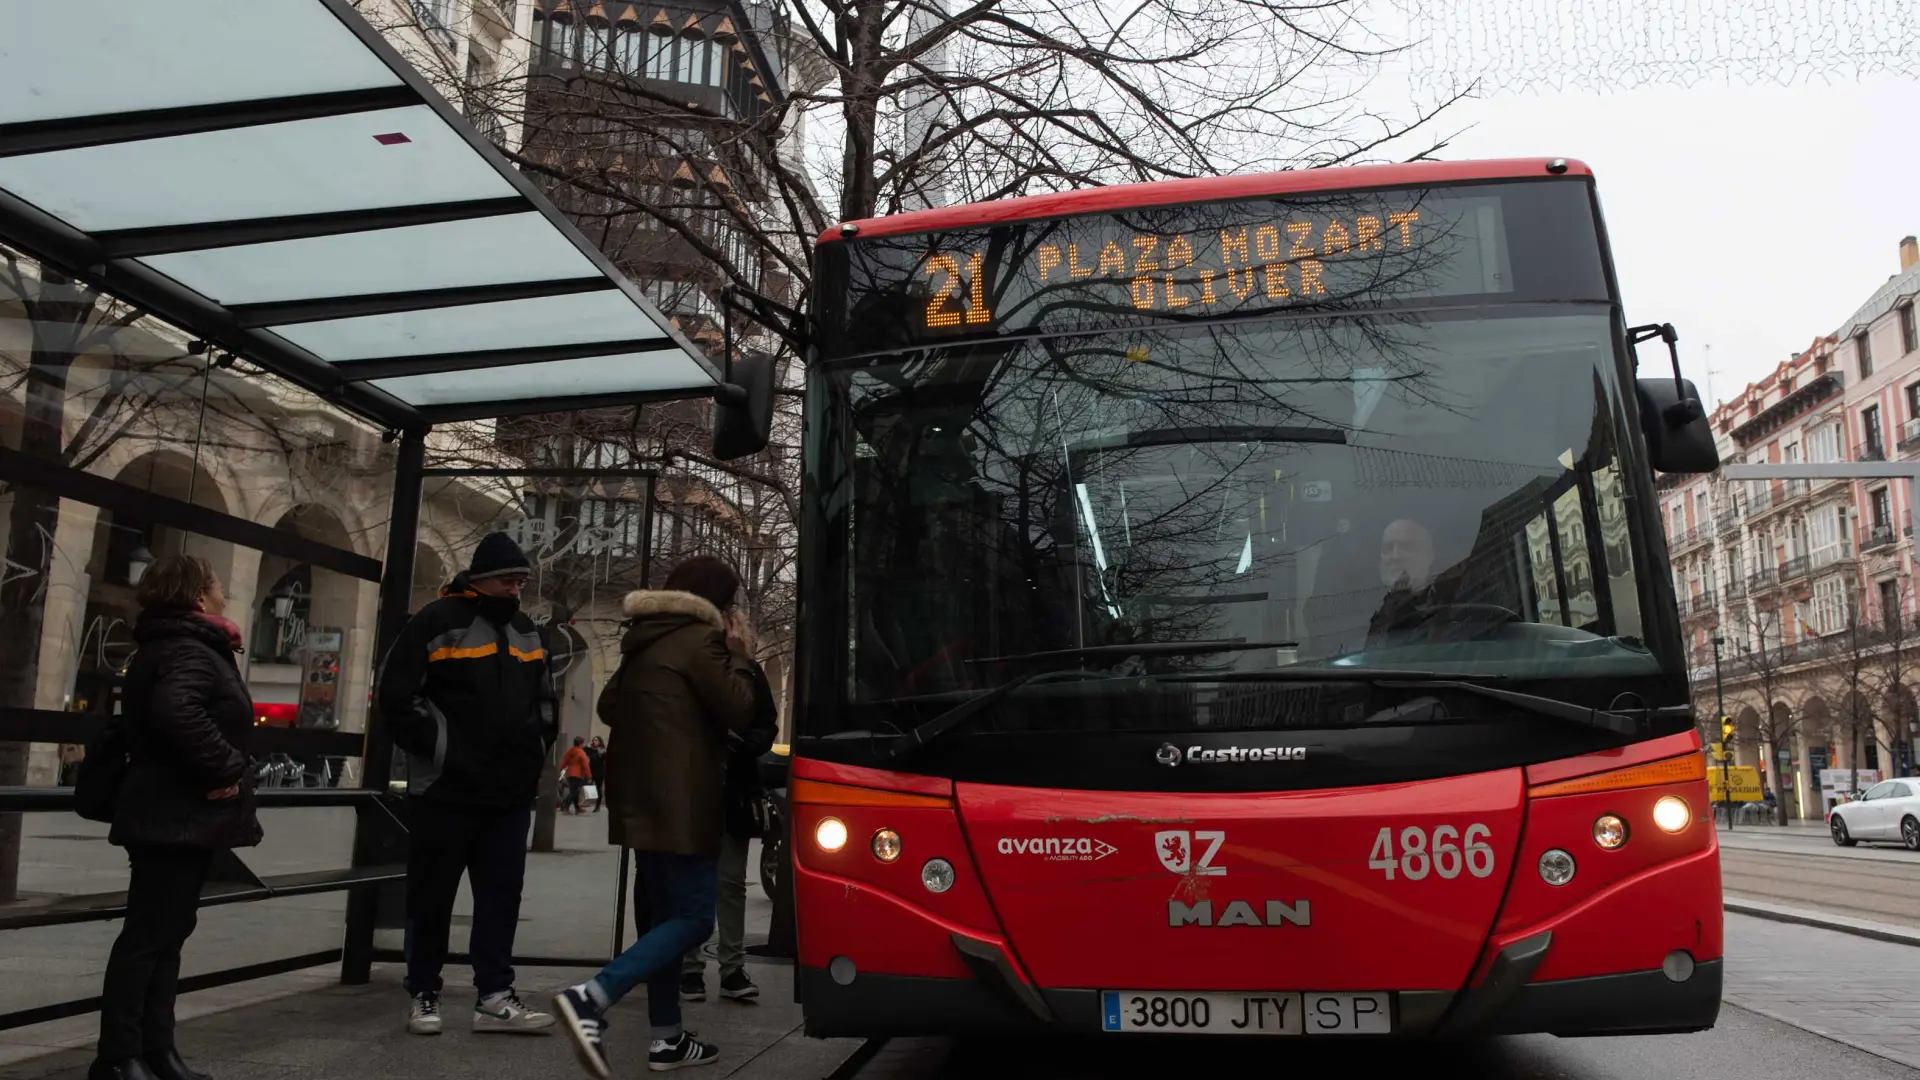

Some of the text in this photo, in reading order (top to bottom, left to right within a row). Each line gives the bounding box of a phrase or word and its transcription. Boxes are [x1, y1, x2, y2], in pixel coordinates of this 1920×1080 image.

[1039, 211, 1420, 281] PLAZA MOZART
[925, 252, 990, 327] 21
[1132, 260, 1325, 310] OLIVER
[1187, 745, 1307, 763] Castrosua
[997, 837, 1092, 855] avanza
[1195, 830, 1227, 876] Z
[1368, 823, 1495, 882] 4866
[1168, 899, 1312, 928] MAN
[1109, 996, 1289, 1030] E 3800 JTY
